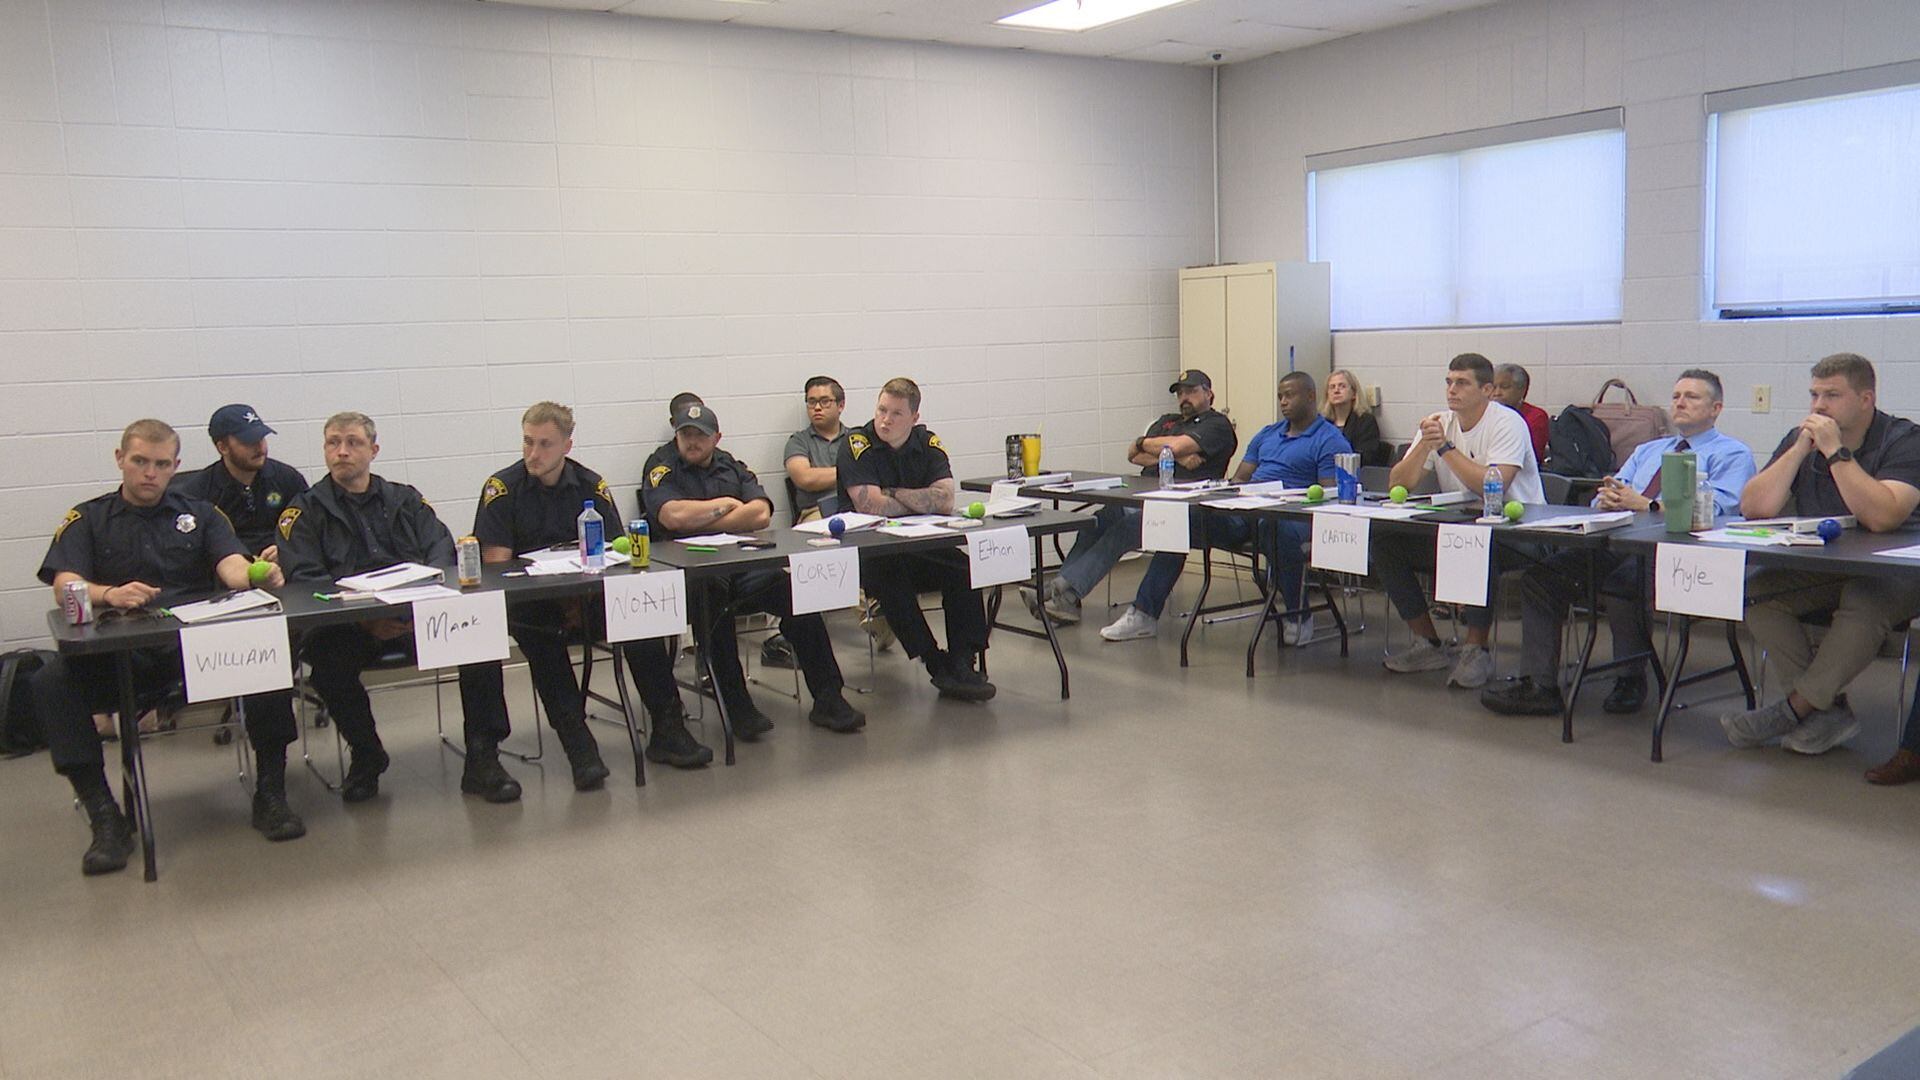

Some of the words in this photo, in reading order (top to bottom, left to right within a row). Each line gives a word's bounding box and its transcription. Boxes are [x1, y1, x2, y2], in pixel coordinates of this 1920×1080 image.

[979, 538, 1015, 561] Ethan
[1321, 529, 1358, 545] CARTER
[1441, 532, 1484, 549] JOHN
[797, 561, 848, 589] COREY
[1672, 556, 1714, 593] Kyle
[611, 583, 678, 622] NOAH
[195, 648, 278, 673] WILLIAM
